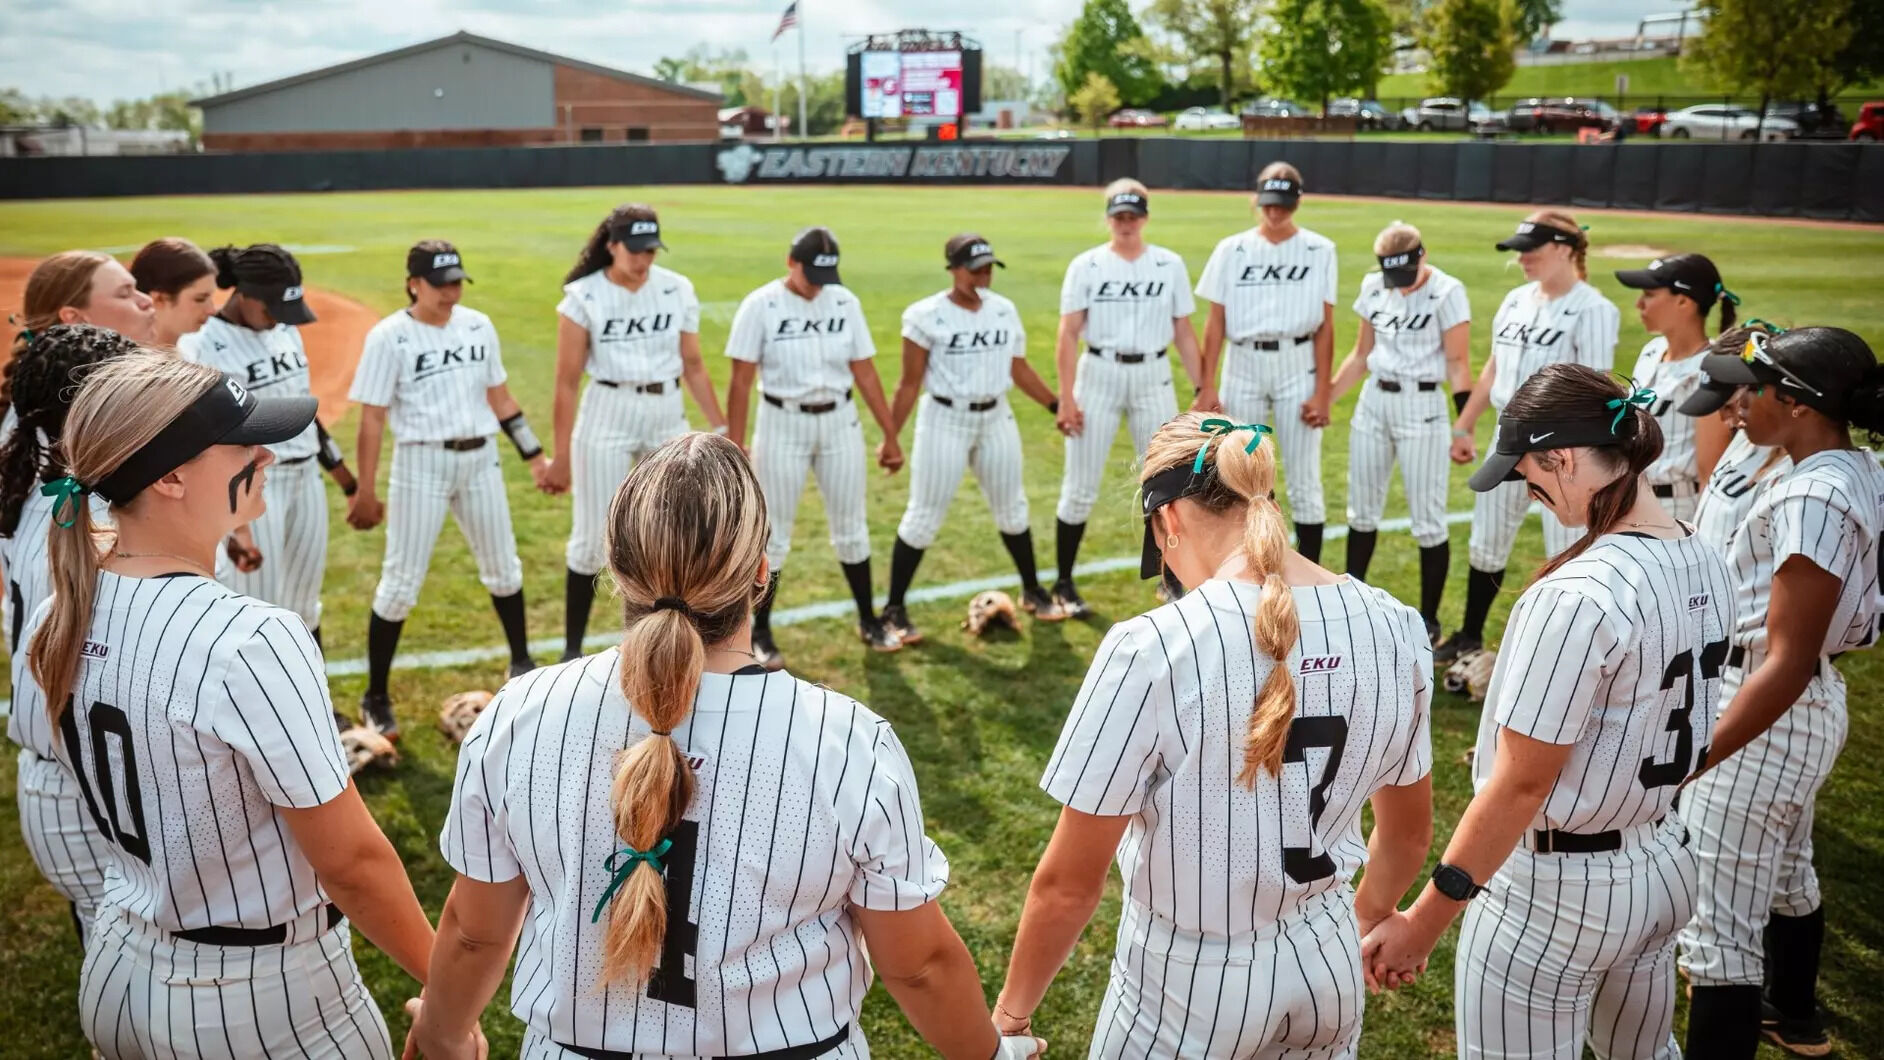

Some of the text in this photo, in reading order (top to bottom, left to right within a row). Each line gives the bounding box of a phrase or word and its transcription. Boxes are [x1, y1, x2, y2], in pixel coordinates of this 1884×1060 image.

[757, 146, 1070, 178] EASTERN KENTUCKY
[1240, 265, 1310, 281] EKU
[1098, 281, 1164, 297] EKU
[602, 313, 673, 337] EKU
[778, 317, 846, 335] EKU
[948, 329, 1008, 349] EKU
[415, 345, 486, 373] EKU
[1689, 595, 1708, 607] EKU
[83, 641, 108, 657] EKU
[1300, 656, 1341, 670] EKU
[60, 692, 151, 868] 10
